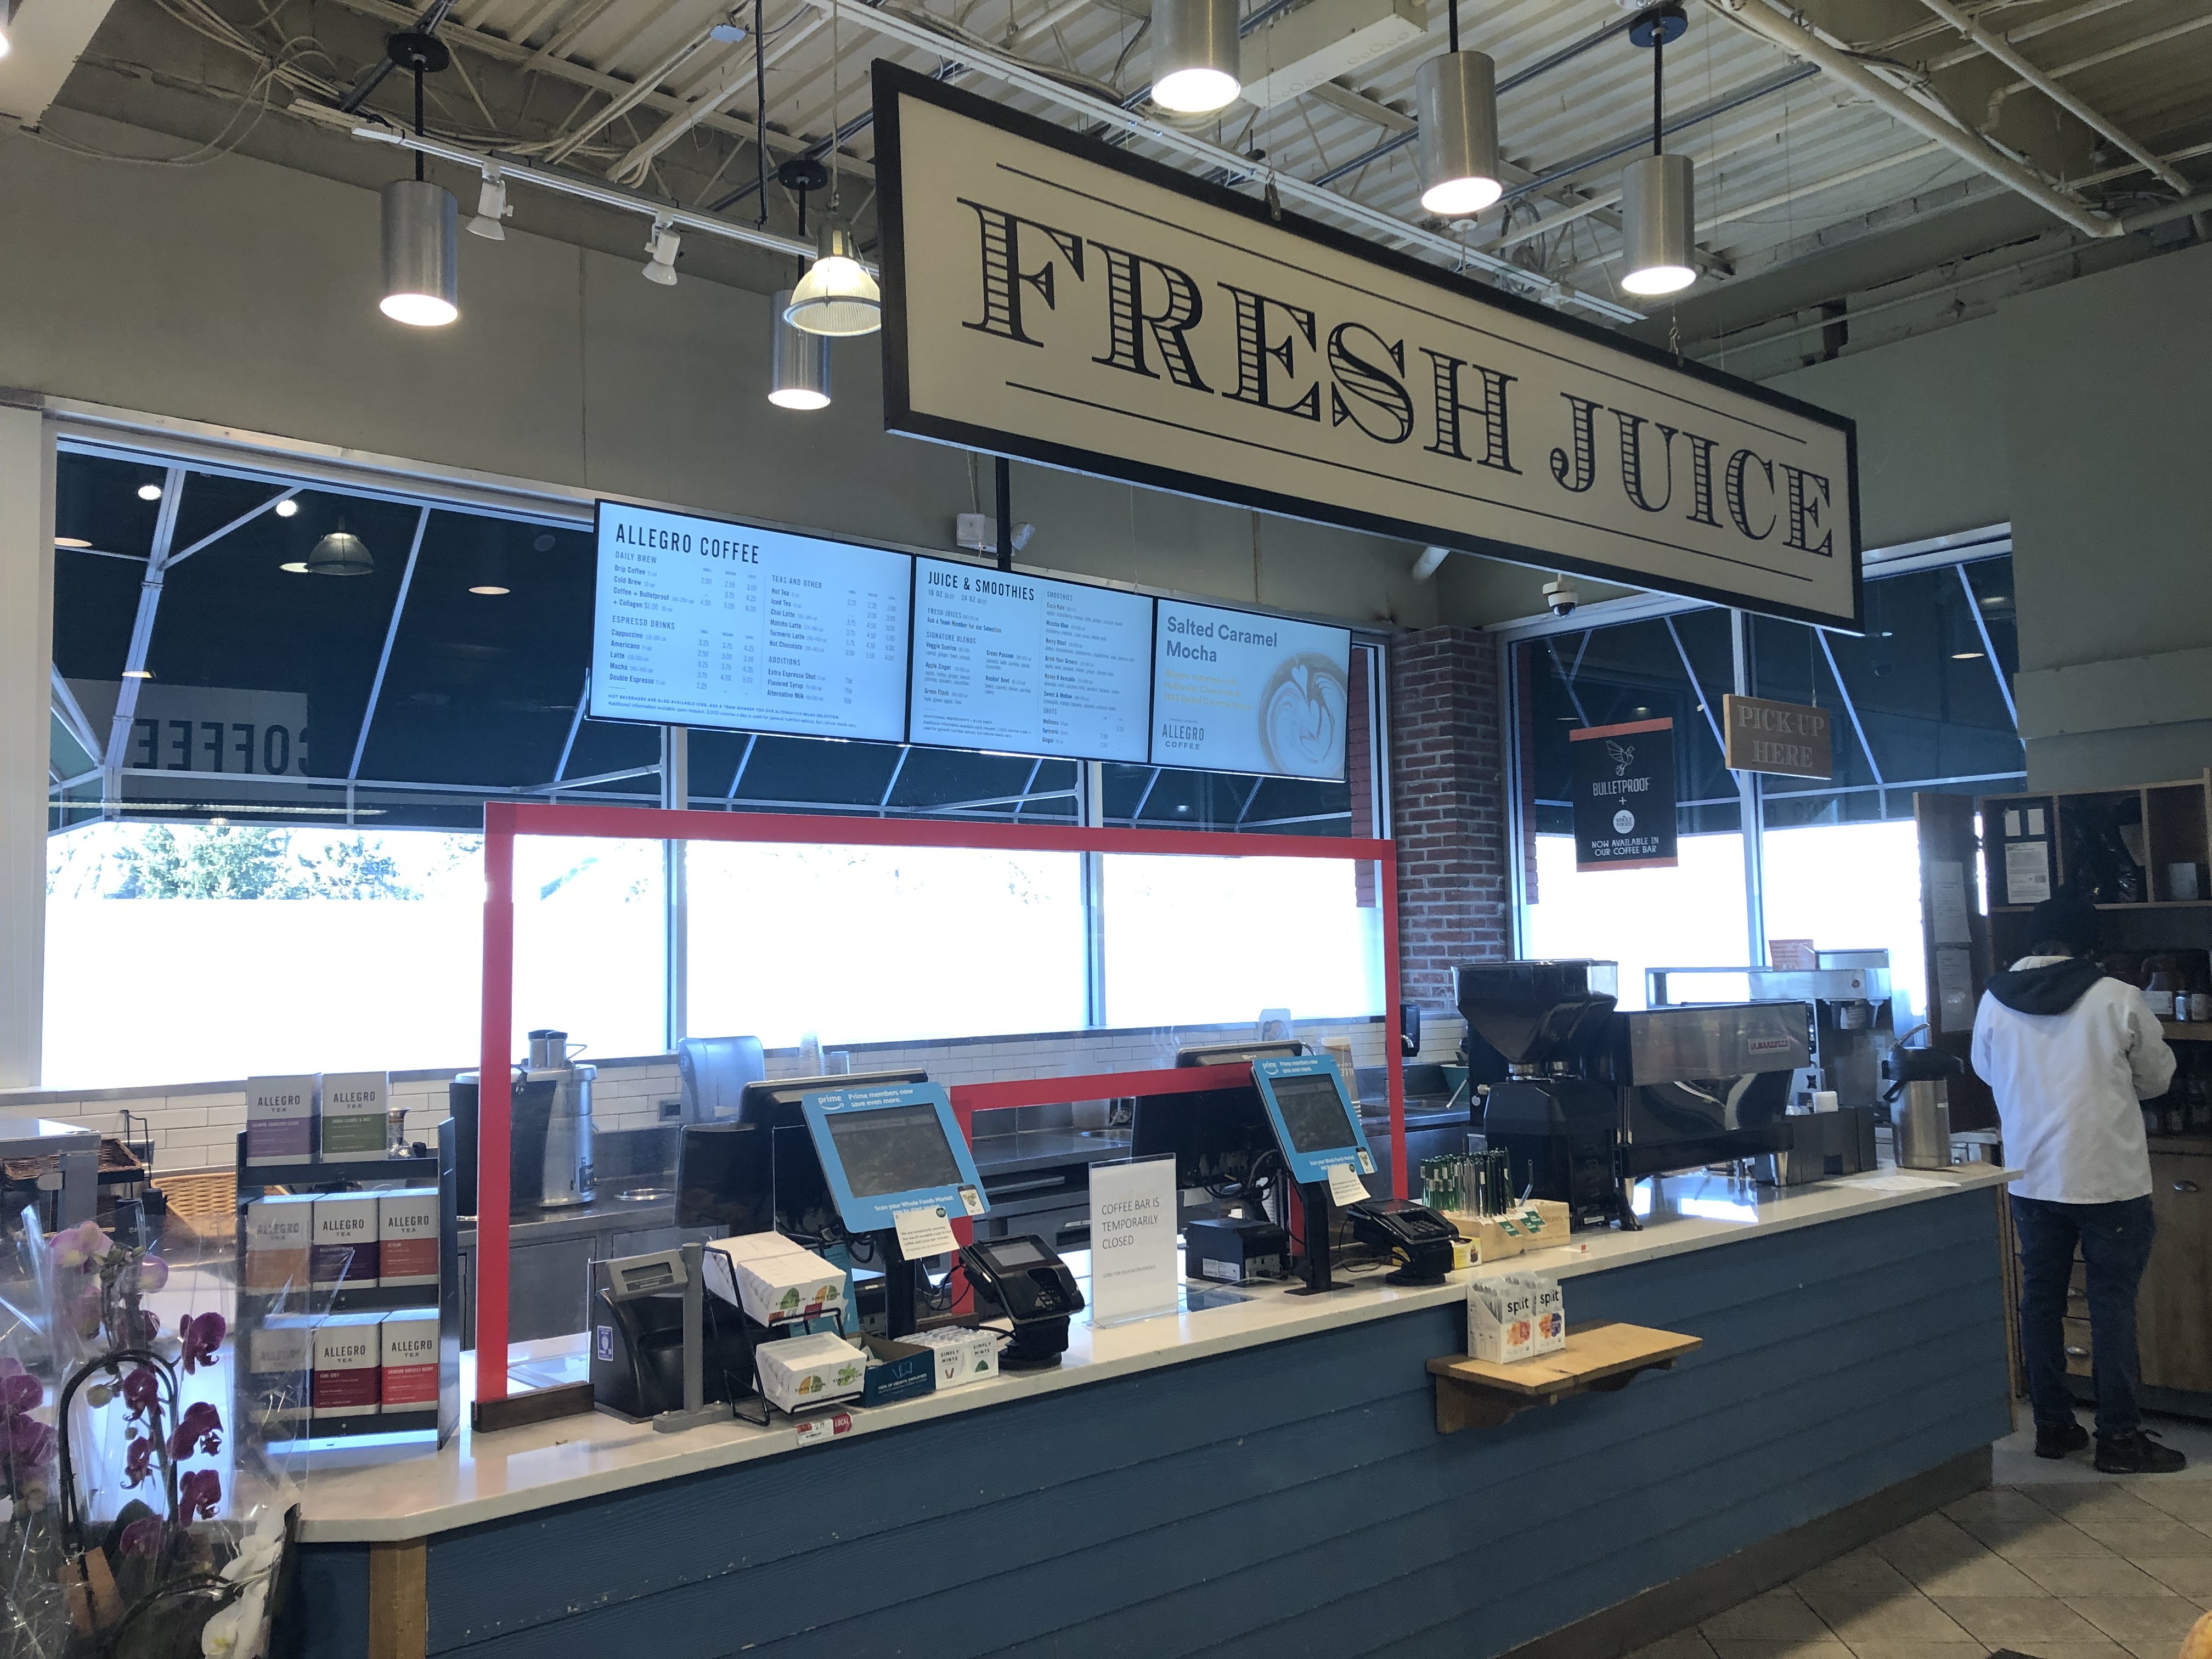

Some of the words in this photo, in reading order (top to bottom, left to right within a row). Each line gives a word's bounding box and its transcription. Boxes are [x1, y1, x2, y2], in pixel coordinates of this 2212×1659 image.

[956, 195, 1523, 477] FRESH
[1549, 391, 1836, 558] JUICE
[616, 523, 691, 553] ALLEGRO
[701, 537, 759, 564] COFFEE
[616, 551, 634, 561] DAILY
[637, 554, 657, 564] BREW
[614, 565, 625, 573] Drip
[628, 567, 645, 575] Coffee
[772, 575, 787, 584] TEAS
[789, 578, 801, 586] AND
[804, 580, 822, 589] OTHER
[928, 571, 958, 588] JUICE
[963, 577, 970, 590] &
[975, 579, 1034, 601] SMOOTHIES
[613, 587, 631, 596] Coffee
[640, 591, 669, 601] Bulletproof
[1047, 591, 1073, 601] SMOOTHIES
[619, 599, 642, 609] Collagen
[945, 610, 961, 618] JUICES
[612, 615, 647, 627] ESPRESSO
[651, 618, 675, 630] DRINKS
[612, 629, 643, 639] Cappuccino
[770, 630, 791, 638] Turmeric
[926, 631, 955, 641] SIGNATURE
[957, 635, 976, 644] BLENDS
[1167, 616, 1214, 638] Salted
[1218, 624, 1277, 648] Caramel
[611, 640, 640, 650] Americano
[779, 641, 803, 650] Chocolate
[1166, 640, 1217, 663] Mocha
[610, 662, 628, 670] Mocha
[769, 656, 800, 666] ADDITIONS
[610, 674, 628, 682] Double
[630, 676, 654, 685] Espresso
[783, 670, 804, 679] Espresso
[767, 690, 793, 698] Alternative
[1737, 704, 1825, 738] PICK-UP
[1162, 724, 1204, 741] ALLEGRO
[1165, 741, 1200, 750] COFFEE
[1752, 740, 1813, 768] HERE
[1593, 777, 1650, 796] BULLETPROOF
[1592, 840, 1609, 849] NOW
[1612, 837, 1648, 847] AVAILABLE
[1594, 848, 1611, 856] OUR
[1613, 847, 1640, 855] COFFEE
[258, 1095, 301, 1107] ALLEGRO
[334, 1091, 376, 1103] ALLEGRO
[818, 1095, 842, 1105] prime
[1102, 1201, 1132, 1215] COFFEE
[1135, 1199, 1150, 1211] BAR
[1153, 1197, 1160, 1207] IS
[323, 1219, 364, 1231] ALLEGRO
[388, 1215, 429, 1227] ALLEGRO
[1102, 1214, 1159, 1232] TEMPORARILY
[1102, 1235, 1134, 1249] CLOSED
[1540, 1289, 1559, 1307] split
[1508, 1297, 1530, 1316] split
[324, 1345, 366, 1357] ALLEGRO
[391, 1340, 432, 1352] ALLEGRO
[835, 1418, 849, 1426] LOCAL
